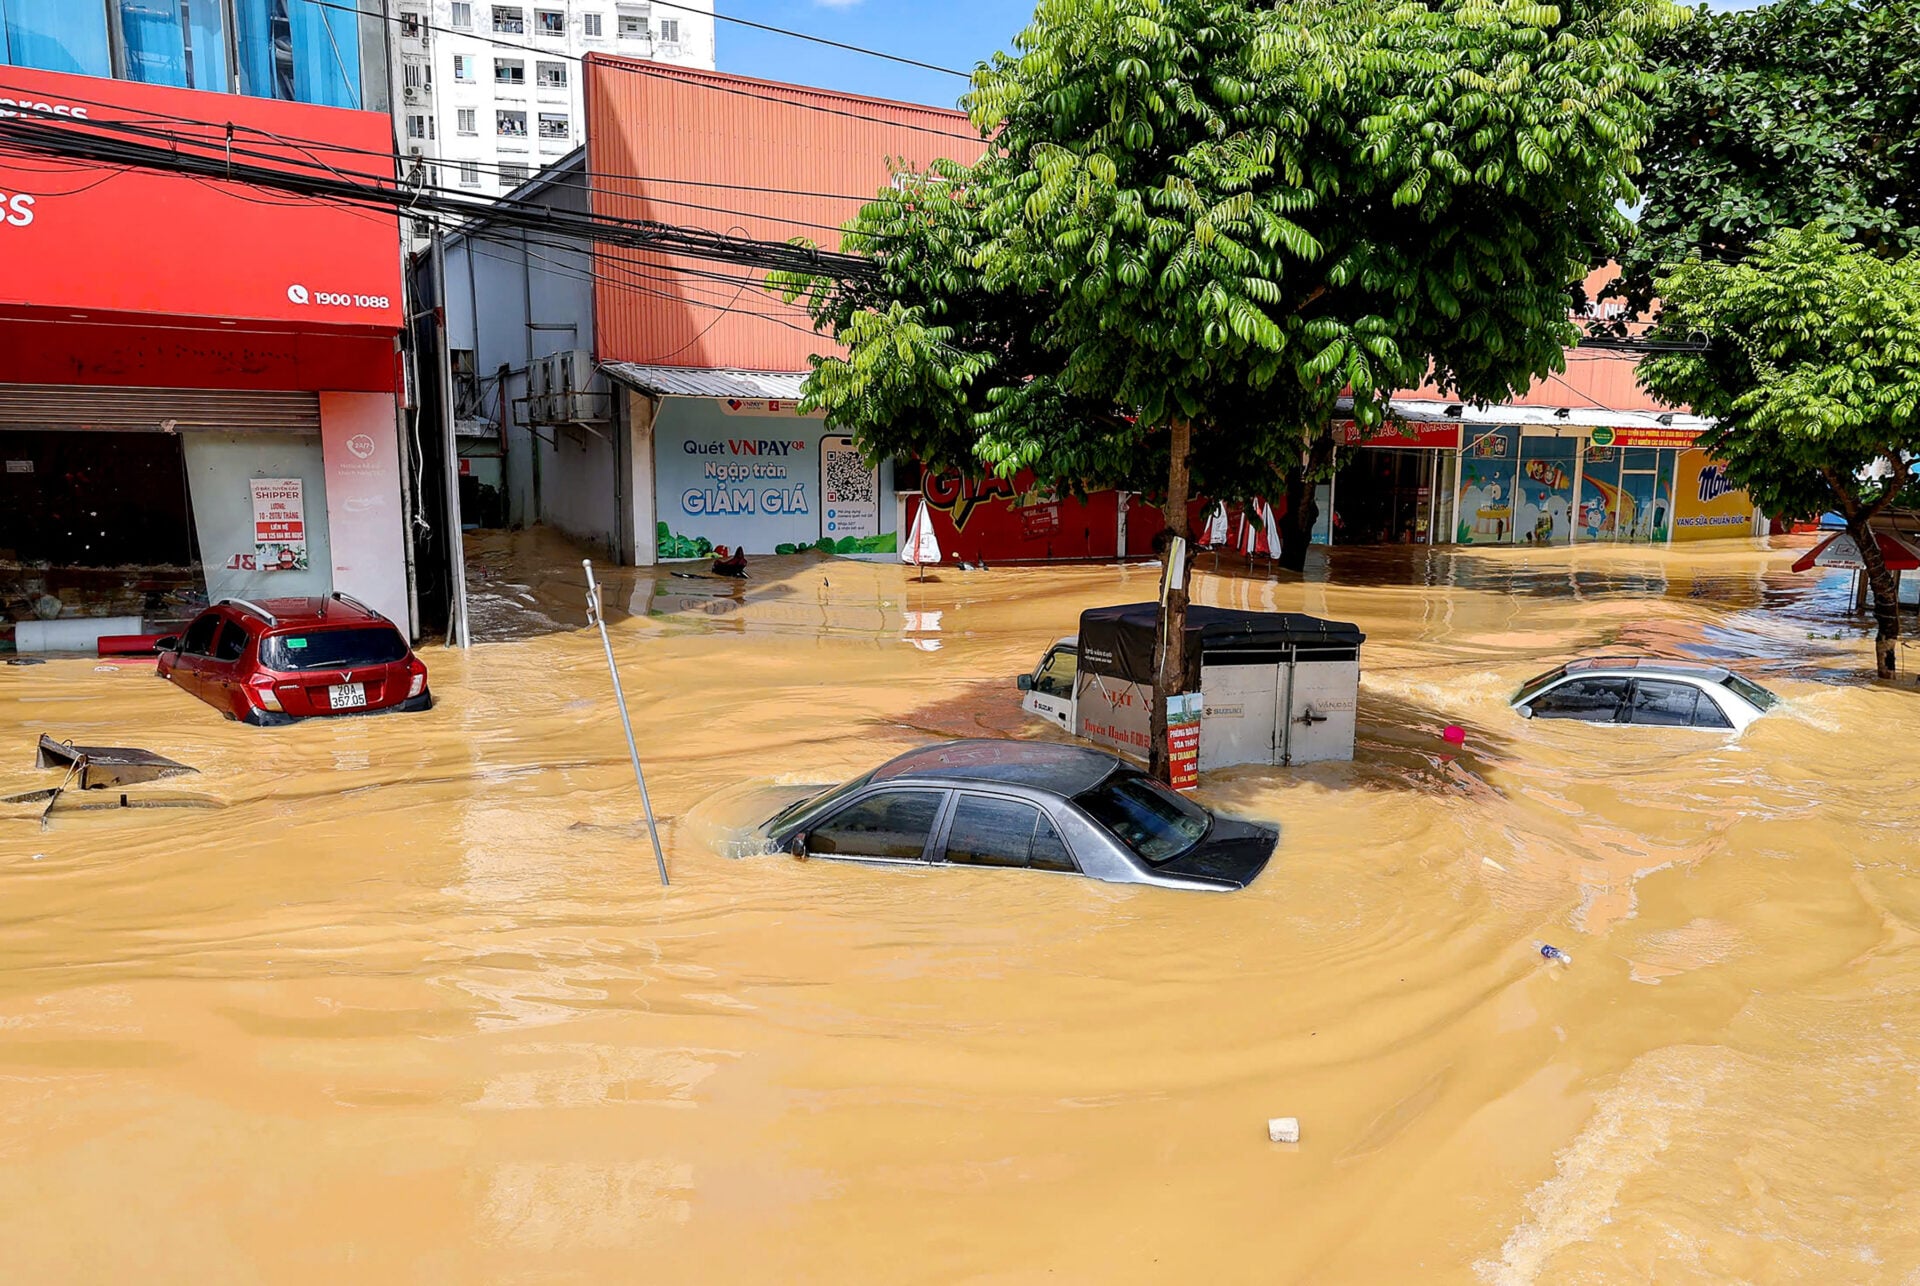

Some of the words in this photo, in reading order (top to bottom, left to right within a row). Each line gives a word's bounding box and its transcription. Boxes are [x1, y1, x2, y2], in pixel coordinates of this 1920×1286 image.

[313, 291, 351, 307] 1900
[353, 294, 390, 309] 1088
[683, 440, 725, 455] Quét
[705, 461, 750, 482] Ngập
[752, 462, 787, 478] tràn
[256, 491, 299, 499] SHIPPER
[682, 483, 755, 514] GIẢM
[760, 483, 808, 514] GIÁ
[338, 684, 356, 696] 20A
[332, 695, 365, 708] 357.05
